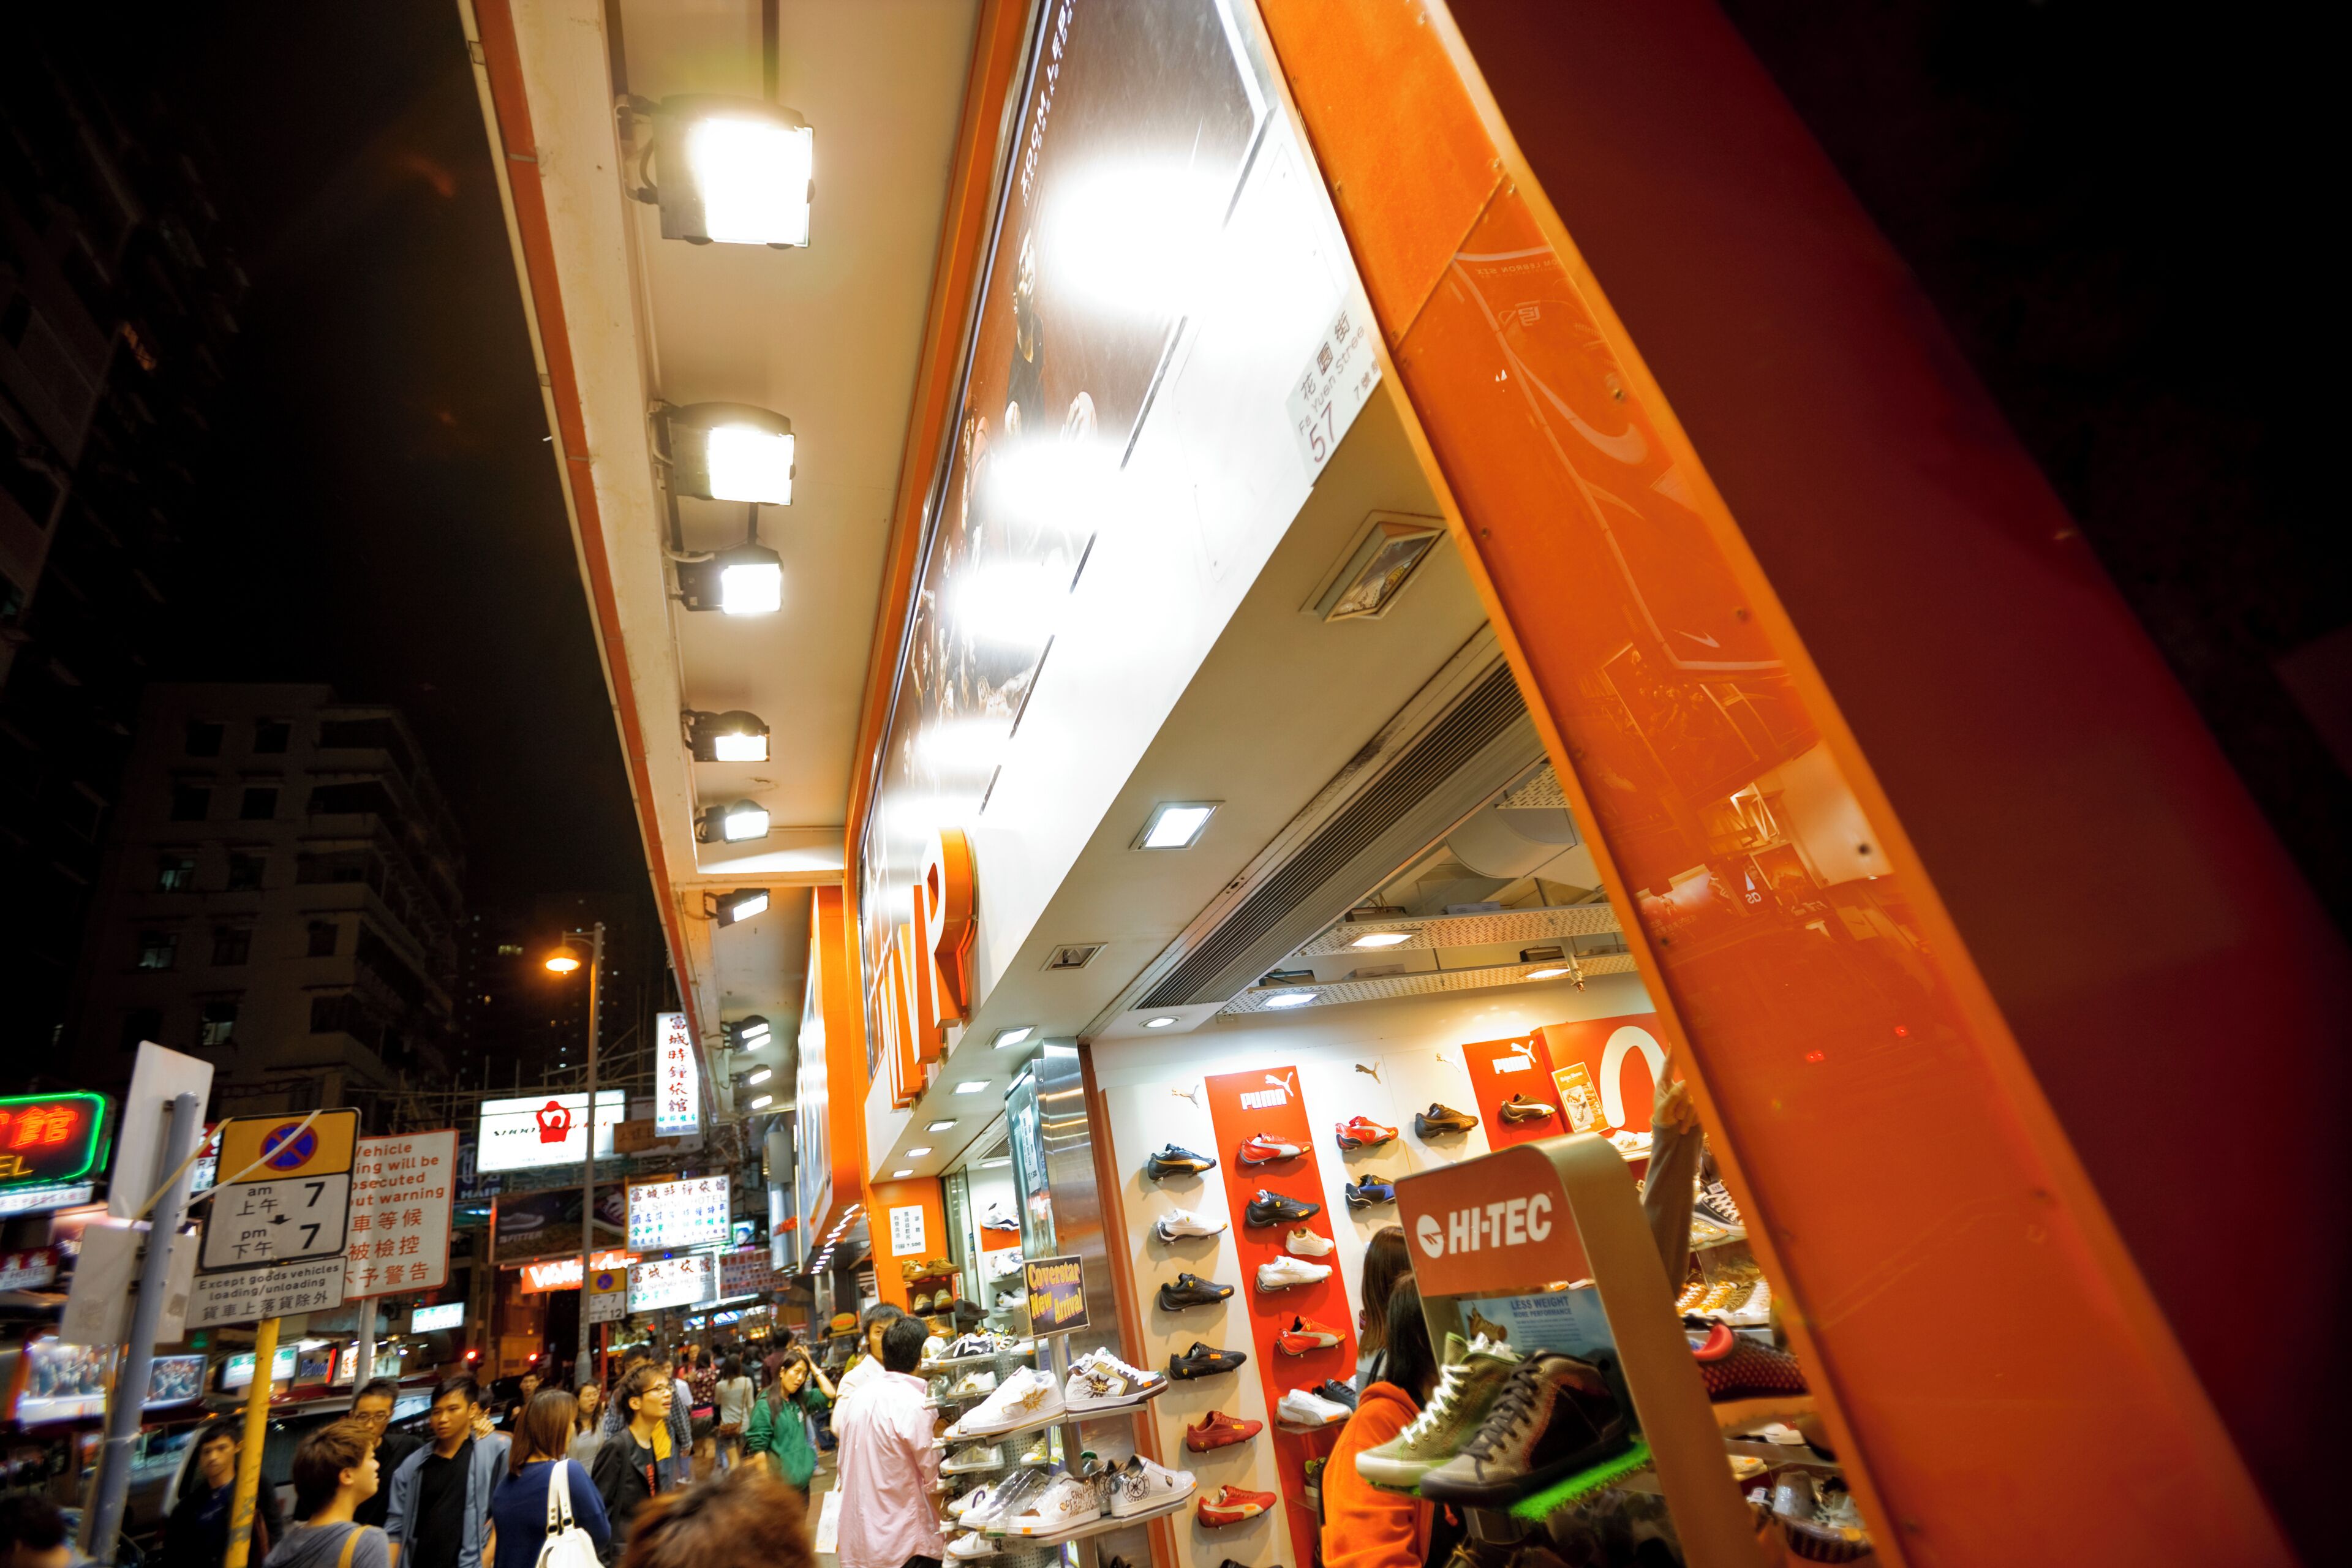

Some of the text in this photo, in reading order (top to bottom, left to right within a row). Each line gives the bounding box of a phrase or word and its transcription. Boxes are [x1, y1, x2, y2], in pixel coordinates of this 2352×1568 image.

[1021, 90, 1046, 196] ZOOM
[1300, 311, 1350, 401] 花園街
[1311, 375, 1336, 413] Yuen
[1310, 399, 1335, 463] 57
[880, 827, 979, 1114] MVP
[668, 1015, 689, 1112] 富城時鐘旅館
[1240, 1088, 1287, 1111] PUMA
[355, 1156, 439, 1175] ing will be
[236, 1198, 279, 1217] 上午
[247, 1181, 326, 1208] am 7
[380, 1187, 445, 1205] warning
[350, 1207, 423, 1234] 車等候
[1448, 1193, 1552, 1255] HI-TEC
[241, 1223, 322, 1250] pm 7
[348, 1234, 420, 1262] 被檢控
[232, 1241, 274, 1260] 下午
[199, 1264, 339, 1291] Except goods vehicles
[209, 1277, 326, 1301] loading/unloading
[1027, 1261, 1080, 1291] Coverstar
[202, 1290, 328, 1321] 貨車上落貨除外
[610, 1294, 617, 1303] 7
[1030, 1287, 1084, 1324] New Arrival
[1510, 1296, 1569, 1310] LESS WEIGHT
[610, 1308, 623, 1318] 12
[1529, 1308, 1572, 1317] PERFORMANCE
